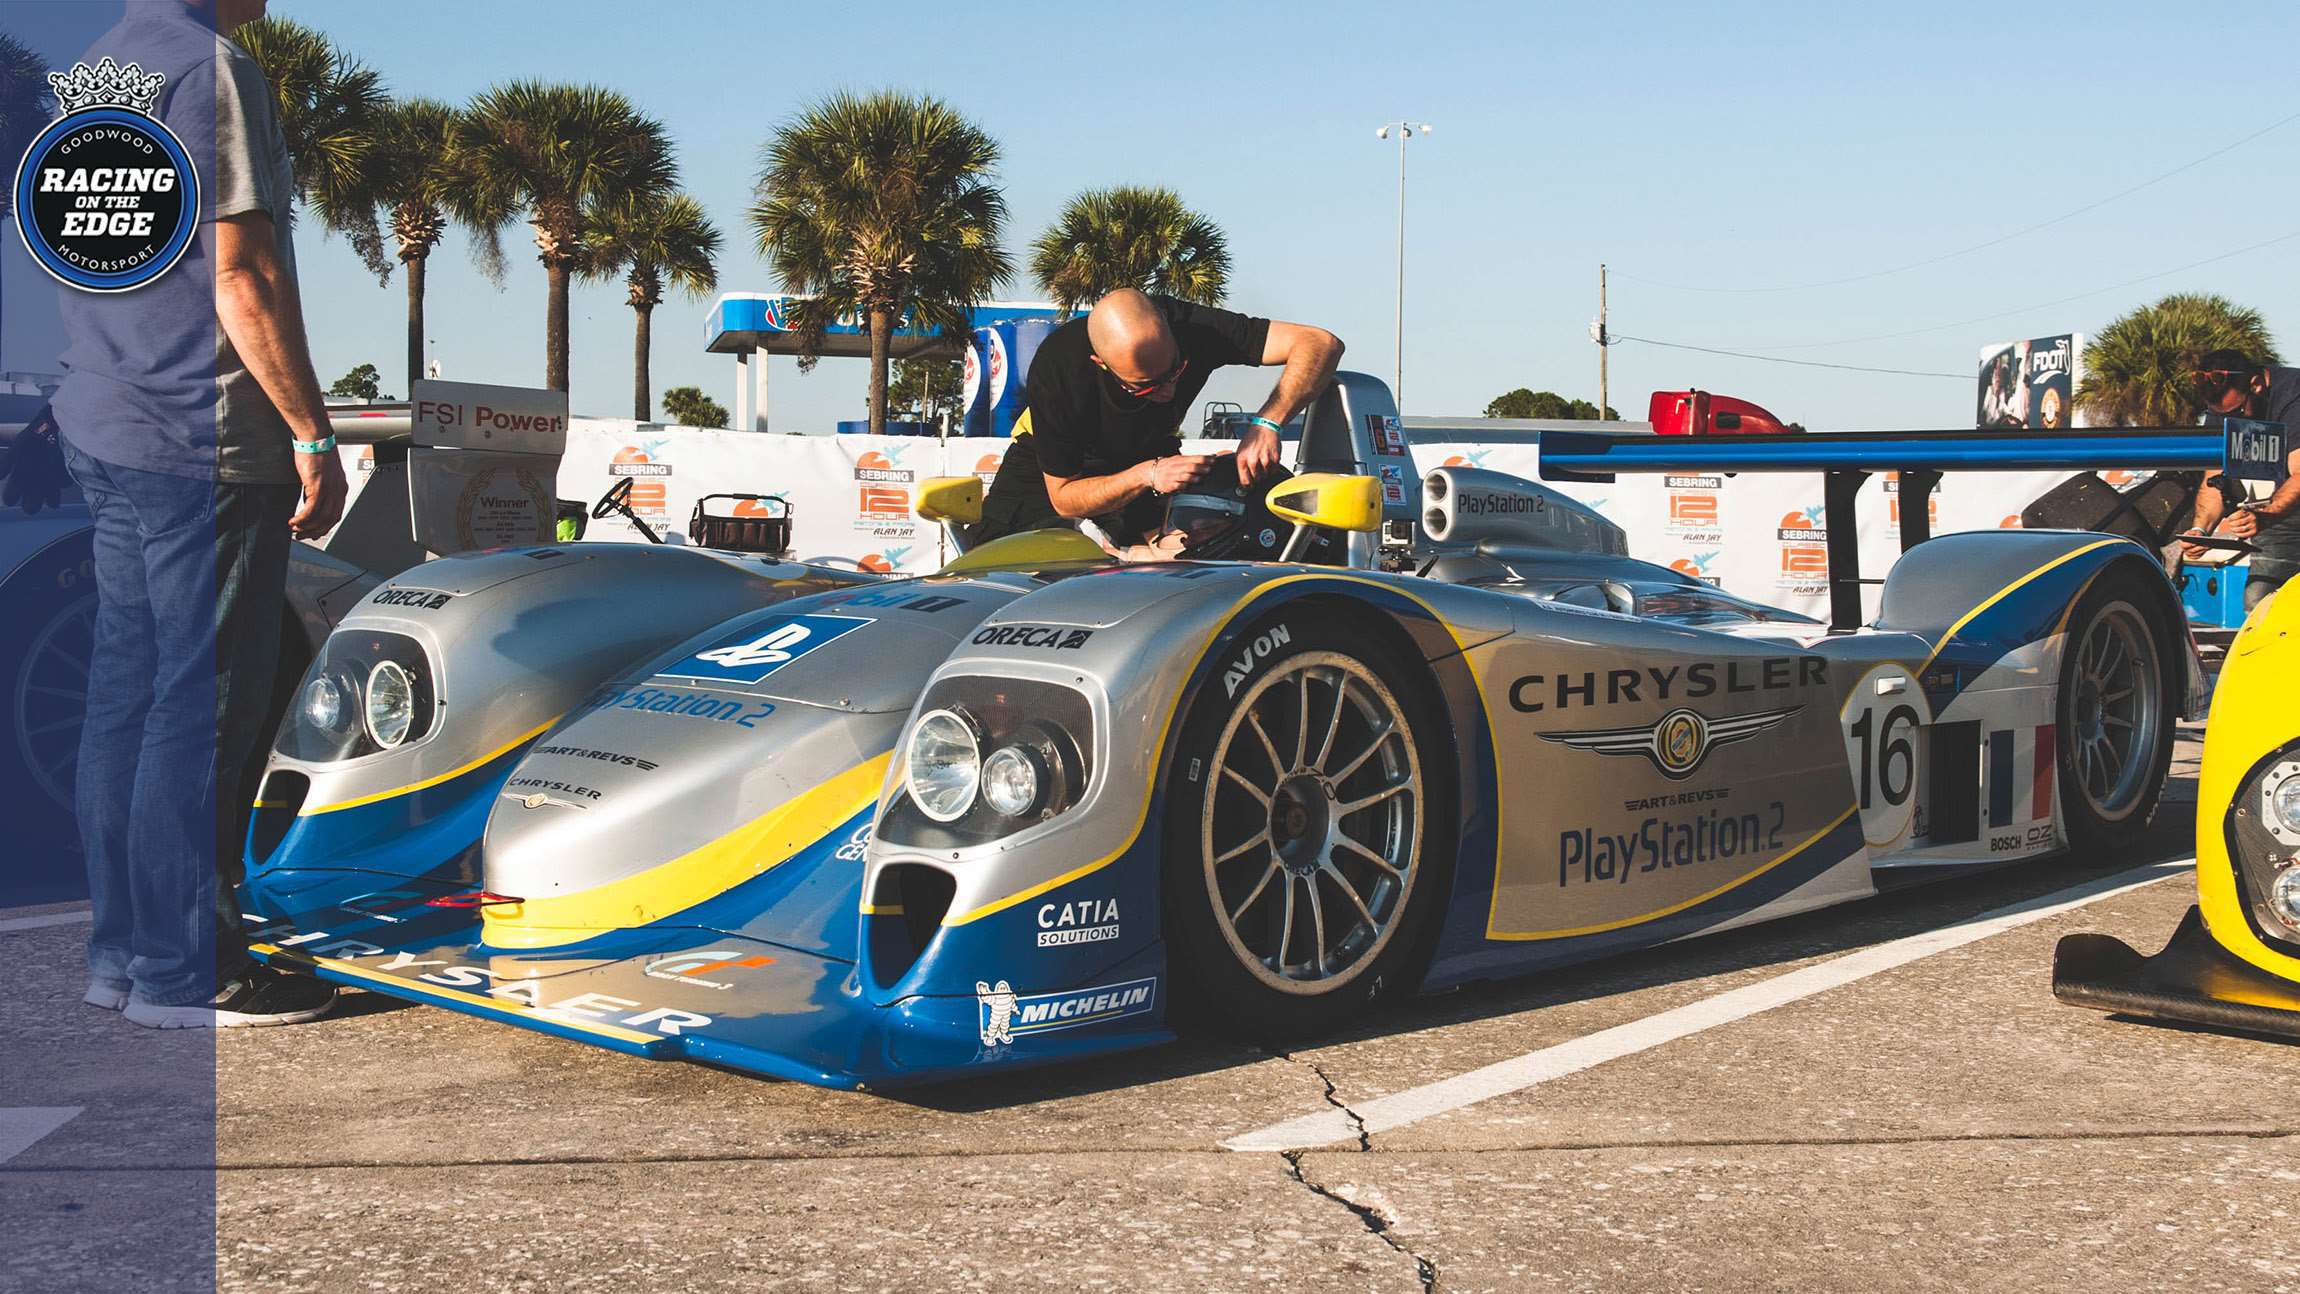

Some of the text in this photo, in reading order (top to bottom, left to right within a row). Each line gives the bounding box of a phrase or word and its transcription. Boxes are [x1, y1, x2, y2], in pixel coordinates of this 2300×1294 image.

[418, 401, 561, 434] FSI Power
[2231, 431, 2266, 462] Mobil
[614, 464, 667, 475] SEBRING
[860, 470, 909, 481] SEBRING
[1669, 478, 1717, 487] SEBRING
[860, 487, 910, 513] 12
[1457, 494, 1545, 515] PlayStation 2
[1670, 496, 1718, 519] 12
[873, 528, 897, 536] ALAN
[1782, 531, 1827, 540] SEBRING
[1782, 548, 1827, 571] 12
[372, 590, 432, 607] ORECA
[971, 626, 1063, 647] ORECA
[1222, 622, 1291, 700] AVON
[1508, 656, 1828, 713] CHRYSLER
[1850, 704, 1919, 810] 16
[510, 778, 602, 800] CHRYSLER
[1991, 836, 2021, 851] BOSCH
[1038, 898, 1119, 929] CATIA
[1039, 926, 1119, 947] SOLUTIONS
[1021, 986, 1149, 1024] MICHELIN
